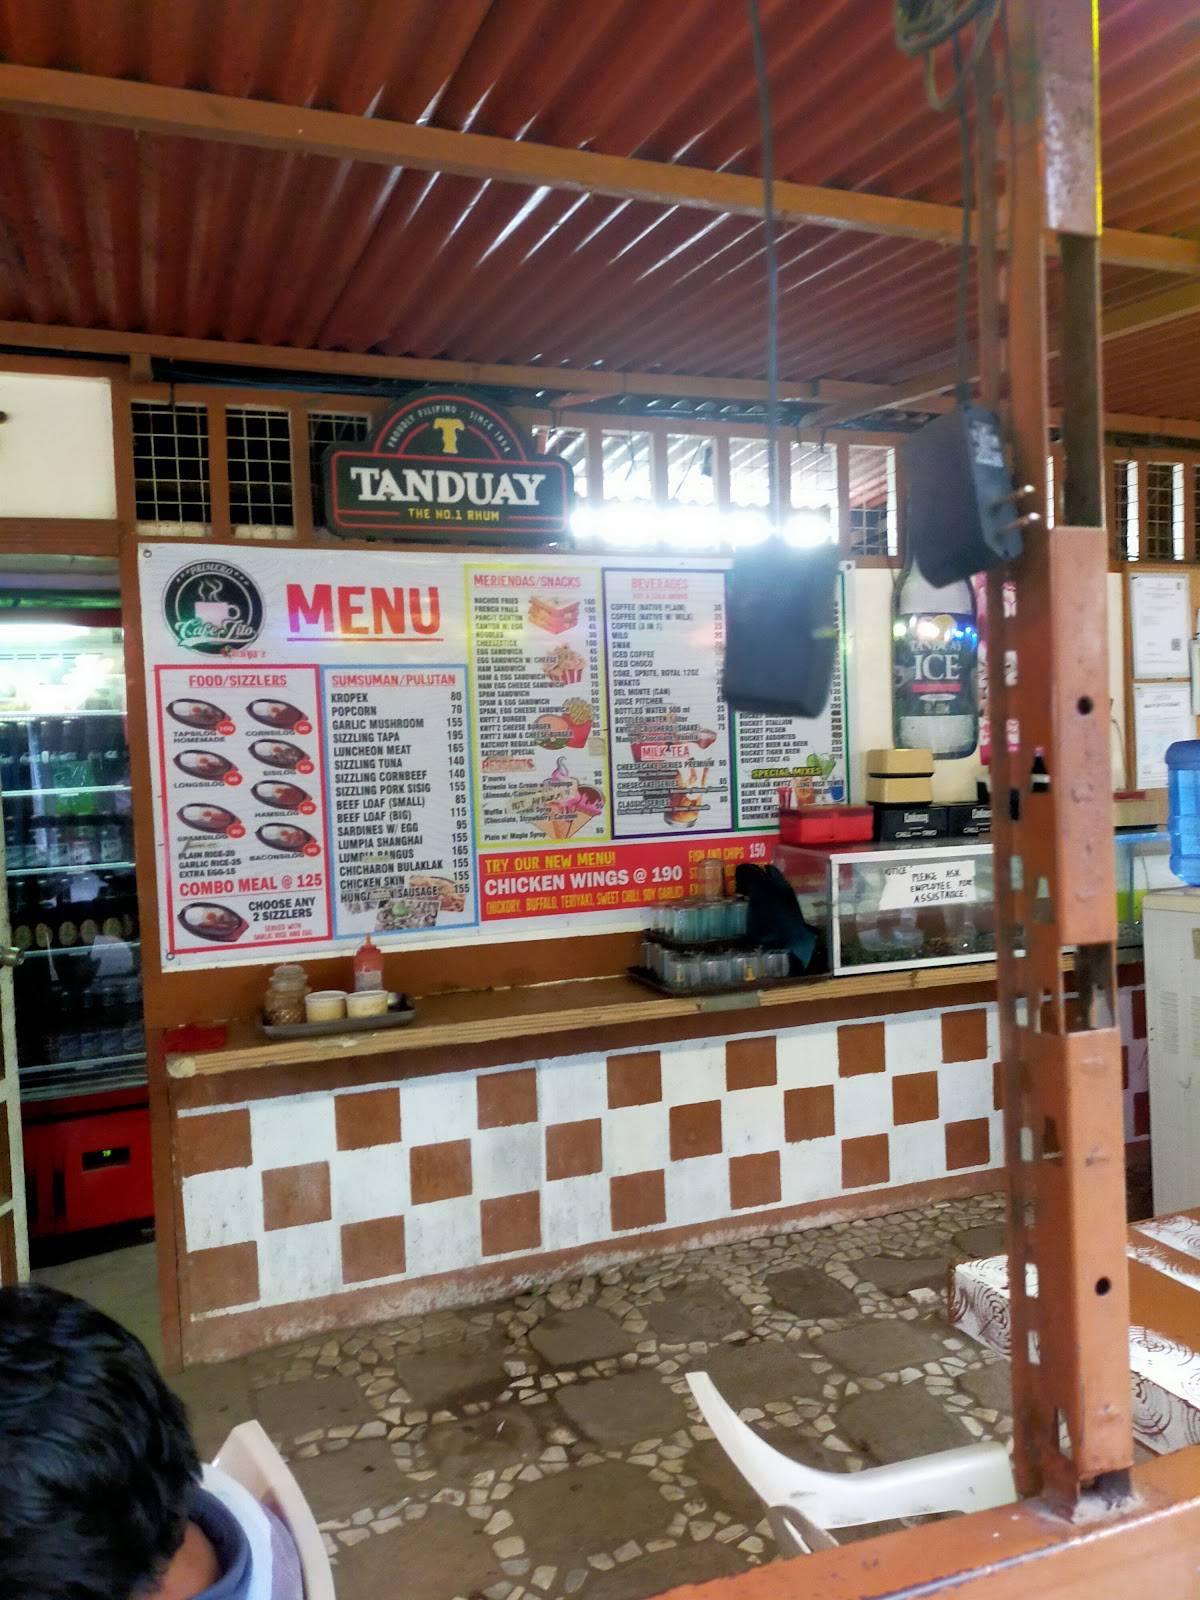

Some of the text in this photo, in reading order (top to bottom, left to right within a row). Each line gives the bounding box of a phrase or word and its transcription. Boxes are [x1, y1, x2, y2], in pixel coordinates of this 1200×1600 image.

[470, 411, 494, 430] SINCE
[351, 467, 545, 506] TANDUAY
[408, 508, 501, 522] THE NO.1 RHUM
[474, 575, 581, 588] MERIENDAS/SNACKS
[287, 584, 441, 634] MENU
[630, 650, 655, 658] COFFEE
[914, 653, 963, 681] ICE
[188, 675, 288, 688] FOOD/SIZZLERS
[331, 674, 456, 687] SUMSUMAN/PULUTAN
[331, 691, 462, 703] KROPEK 80
[331, 705, 463, 717] POPCORN 70
[332, 717, 463, 730] GARLIC MUSHROOM 155
[333, 730, 463, 744] SIZZLING TAPA 195
[334, 743, 464, 757] LUNCHEON MEAT 165
[671, 744, 690, 758] TEA
[334, 756, 465, 770] SIZZLING TUNA 140
[335, 769, 465, 783] SIZZLING CORNBEEF 140
[335, 782, 466, 797] SIZZLING PORK SISIG 155
[336, 794, 467, 811] BEEF LOAF (SMALL) 85
[337, 808, 467, 824] BEEF LOAF (BIG) 115
[338, 825, 383, 837] SARDINES
[401, 822, 419, 833] EGG
[456, 820, 468, 829] 95
[338, 833, 469, 850] LUMPIA SHANGHAI 155
[453, 845, 469, 855] 165
[750, 842, 766, 858] 150
[340, 858, 470, 877] CHICHARON BULAKLAK 155
[485, 851, 616, 873] TRY OUR NEW MENU!
[179, 870, 205, 879] EXTRA
[340, 871, 470, 890] CHICKEN SKIN 155
[484, 864, 684, 896] CHICKEN WINGS @ 190
[179, 873, 322, 897] COMBO MEAL @ 125
[398, 886, 438, 898] SAUSAGE
[455, 883, 470, 894] 155
[248, 896, 316, 911] CHOOSE ANY
[596, 891, 619, 906] SWEET
[252, 908, 312, 921] 2 SIZZLERS
